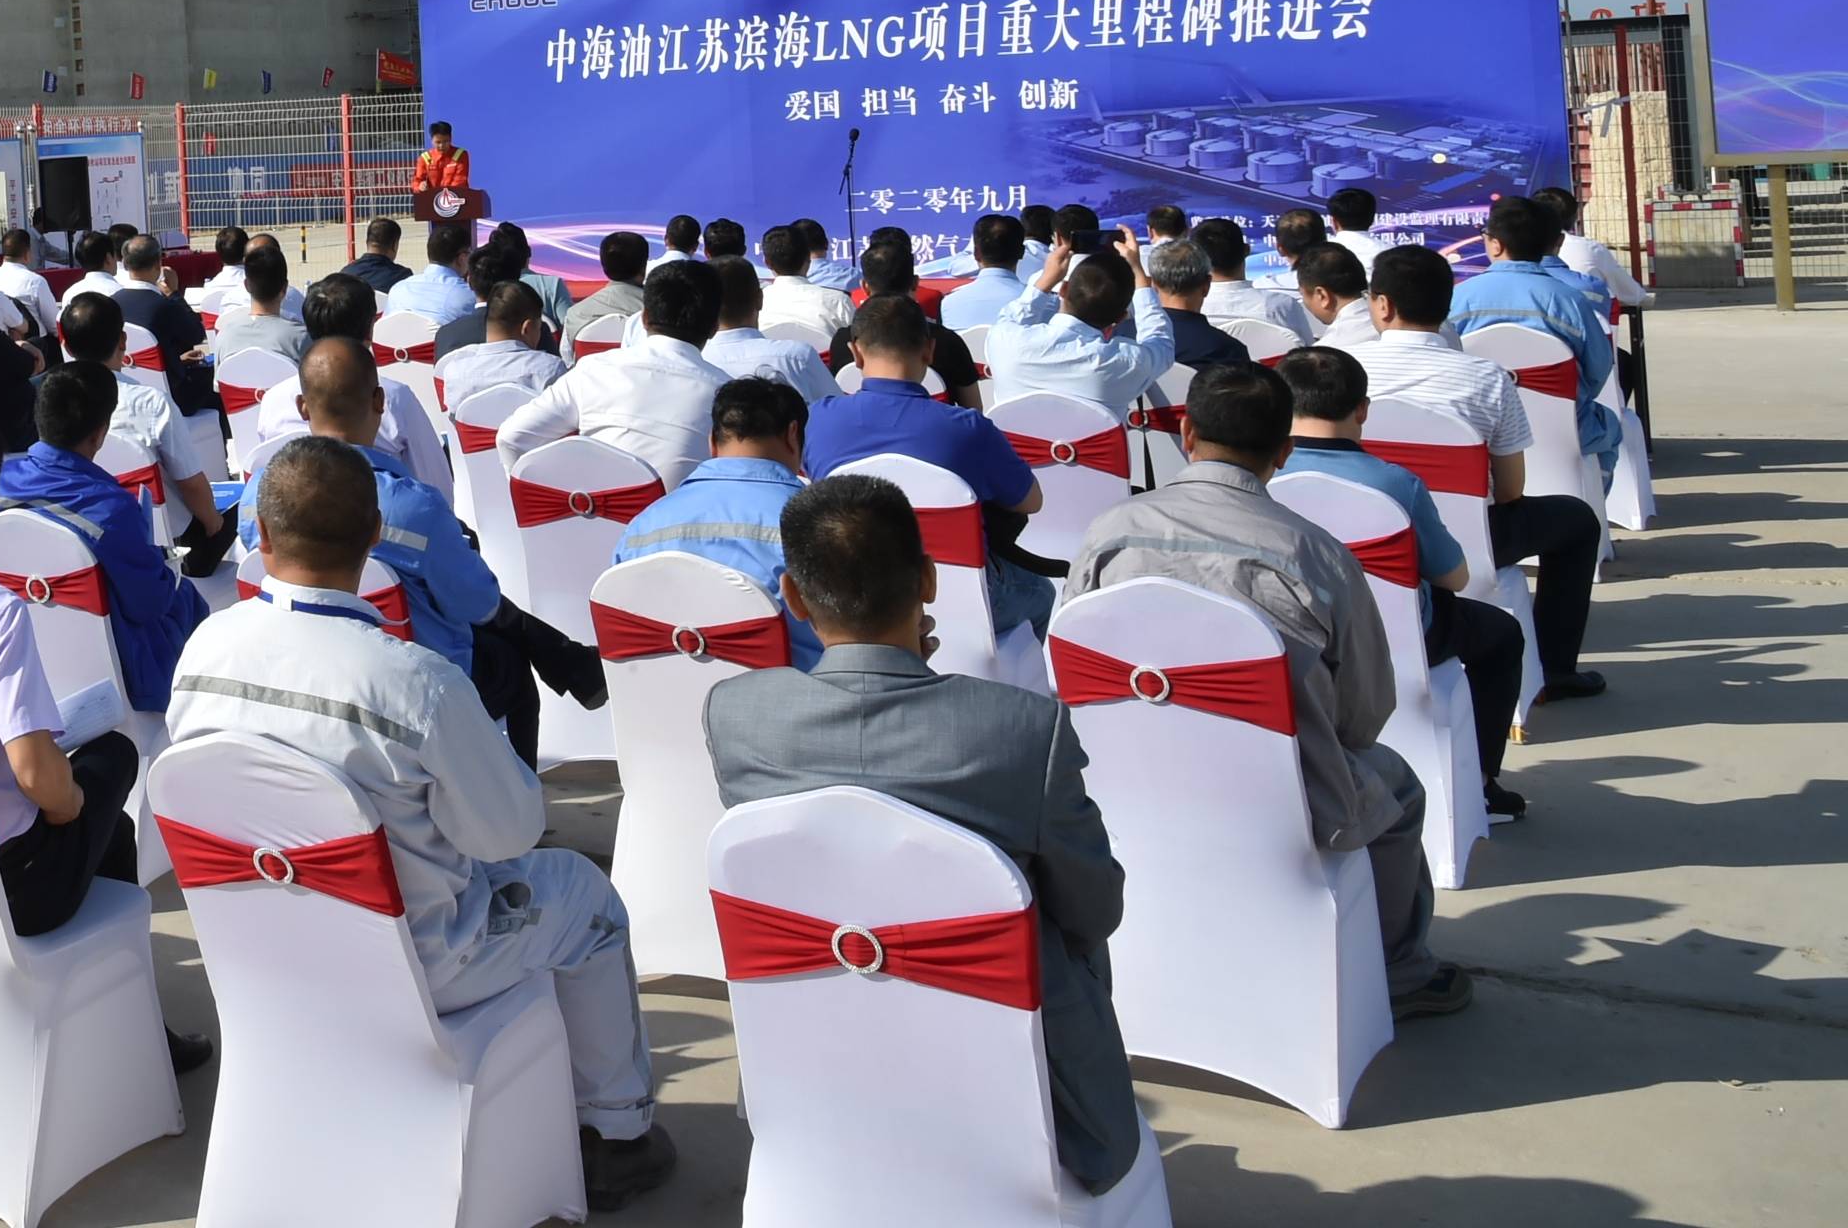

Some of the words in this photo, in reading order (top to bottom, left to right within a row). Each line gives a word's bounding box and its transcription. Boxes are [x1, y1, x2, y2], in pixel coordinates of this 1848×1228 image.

[784, 88, 841, 122] 爱国
[861, 85, 917, 118] 担当
[939, 80, 997, 114] 奋斗
[1018, 77, 1079, 111] 创新
[844, 184, 1029, 214] 二零二零年九月
